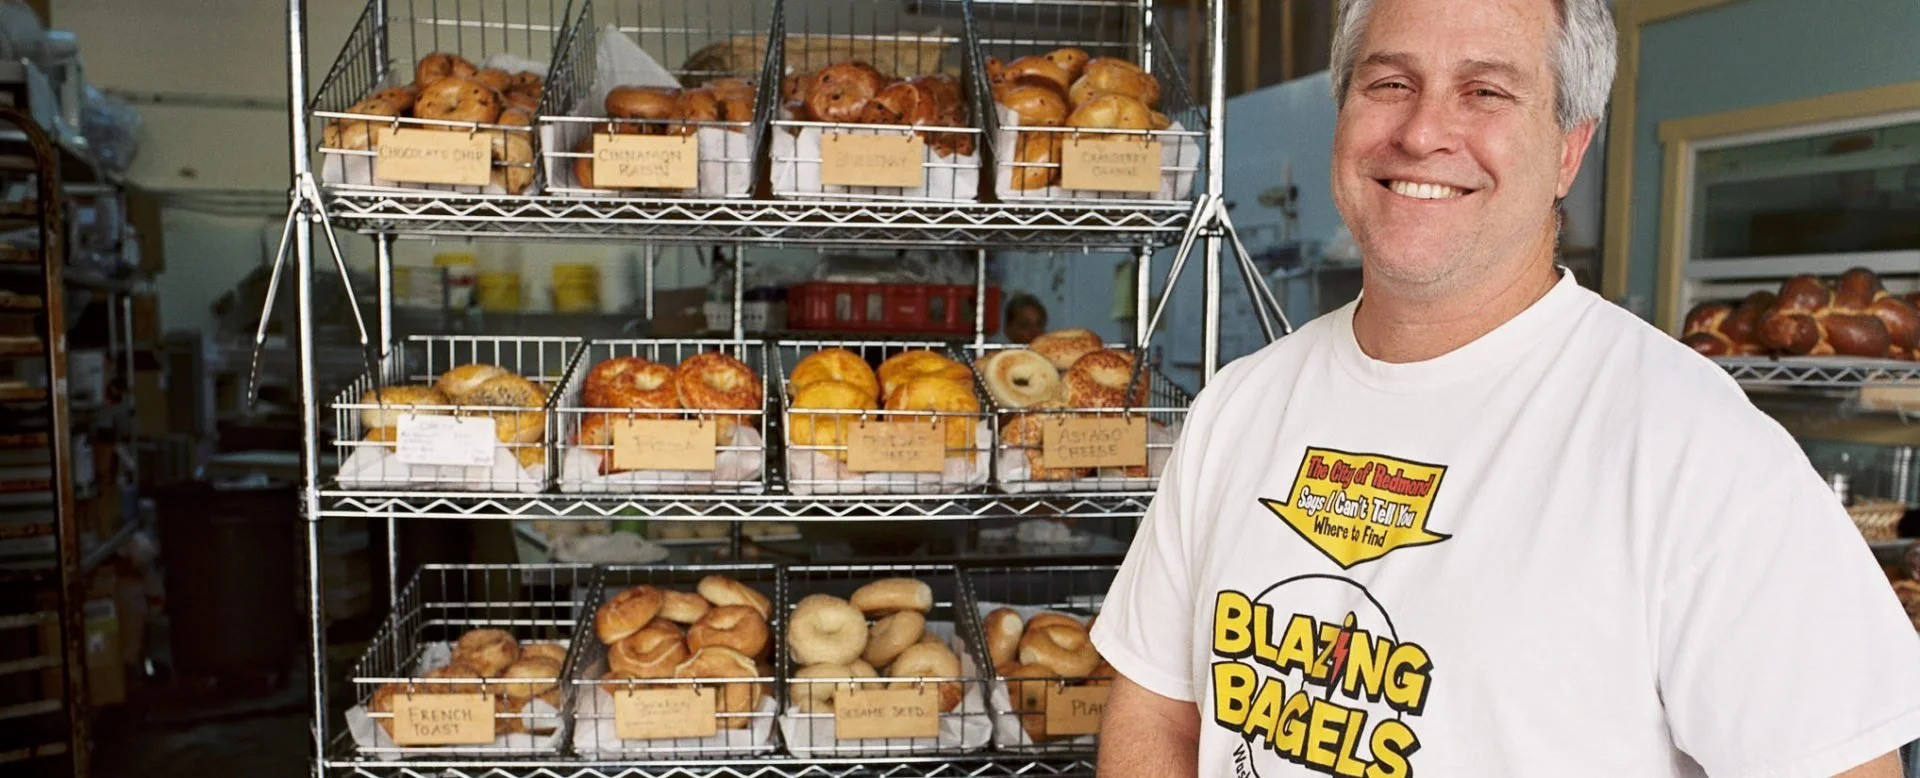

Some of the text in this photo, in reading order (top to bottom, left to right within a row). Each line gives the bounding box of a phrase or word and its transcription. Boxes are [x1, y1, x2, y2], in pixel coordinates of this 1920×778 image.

[598, 148, 682, 162] CINNAMON
[1059, 427, 1122, 443] ASIAGO
[1057, 444, 1119, 461] CHEESE
[1306, 456, 1436, 497] The City of Redmond
[1297, 485, 1417, 528] Says I Can't Tell You
[1313, 515, 1387, 547] Where to Find
[1212, 589, 1433, 717] BLAZING
[408, 706, 473, 724] FRENCH
[1071, 699, 1104, 717] PLAI
[1211, 660, 1421, 778] BAGELS
[414, 723, 460, 737] TOAST
